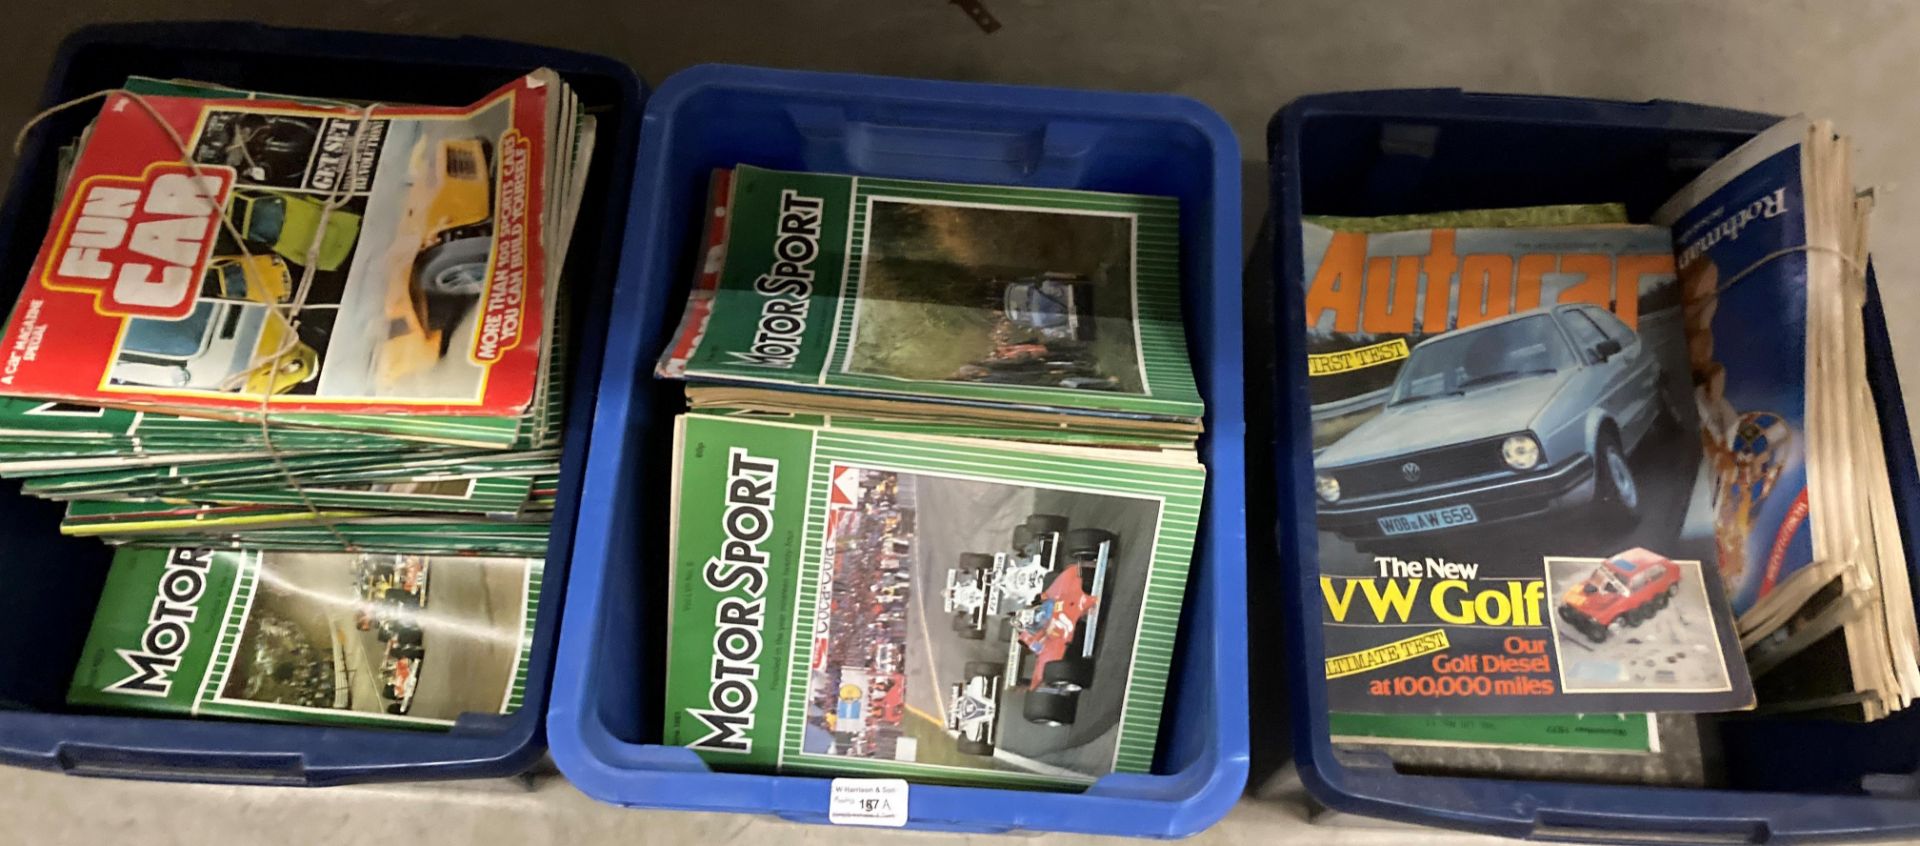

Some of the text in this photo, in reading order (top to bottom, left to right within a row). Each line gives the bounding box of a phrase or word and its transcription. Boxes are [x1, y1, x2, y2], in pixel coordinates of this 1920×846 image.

[312, 119, 351, 190] GET SET
[58, 186, 142, 280] FUN
[113, 173, 224, 308] CAR
[478, 135, 516, 359] MORE THAN 100 SPORTS CARS
[500, 147, 527, 341] YOU CAN BUILD YOURSELF
[1305, 229, 1678, 334] Autocar
[0, 375, 14, 385] A
[13, 299, 44, 350] MAGAZINE
[22, 323, 48, 361] SPECIAL
[1355, 342, 1405, 366] TEST
[1381, 517, 1411, 533] WOB
[1441, 506, 1474, 525] 658
[1374, 556, 1478, 580] The New
[101, 547, 214, 697] MOTOR
[1320, 576, 1544, 626] VW Golf
[1401, 632, 1446, 657] TEST
[1432, 654, 1550, 673] Golf Diesel
[1504, 636, 1547, 654] Our
[1369, 675, 1555, 698] at 100,000 miles
